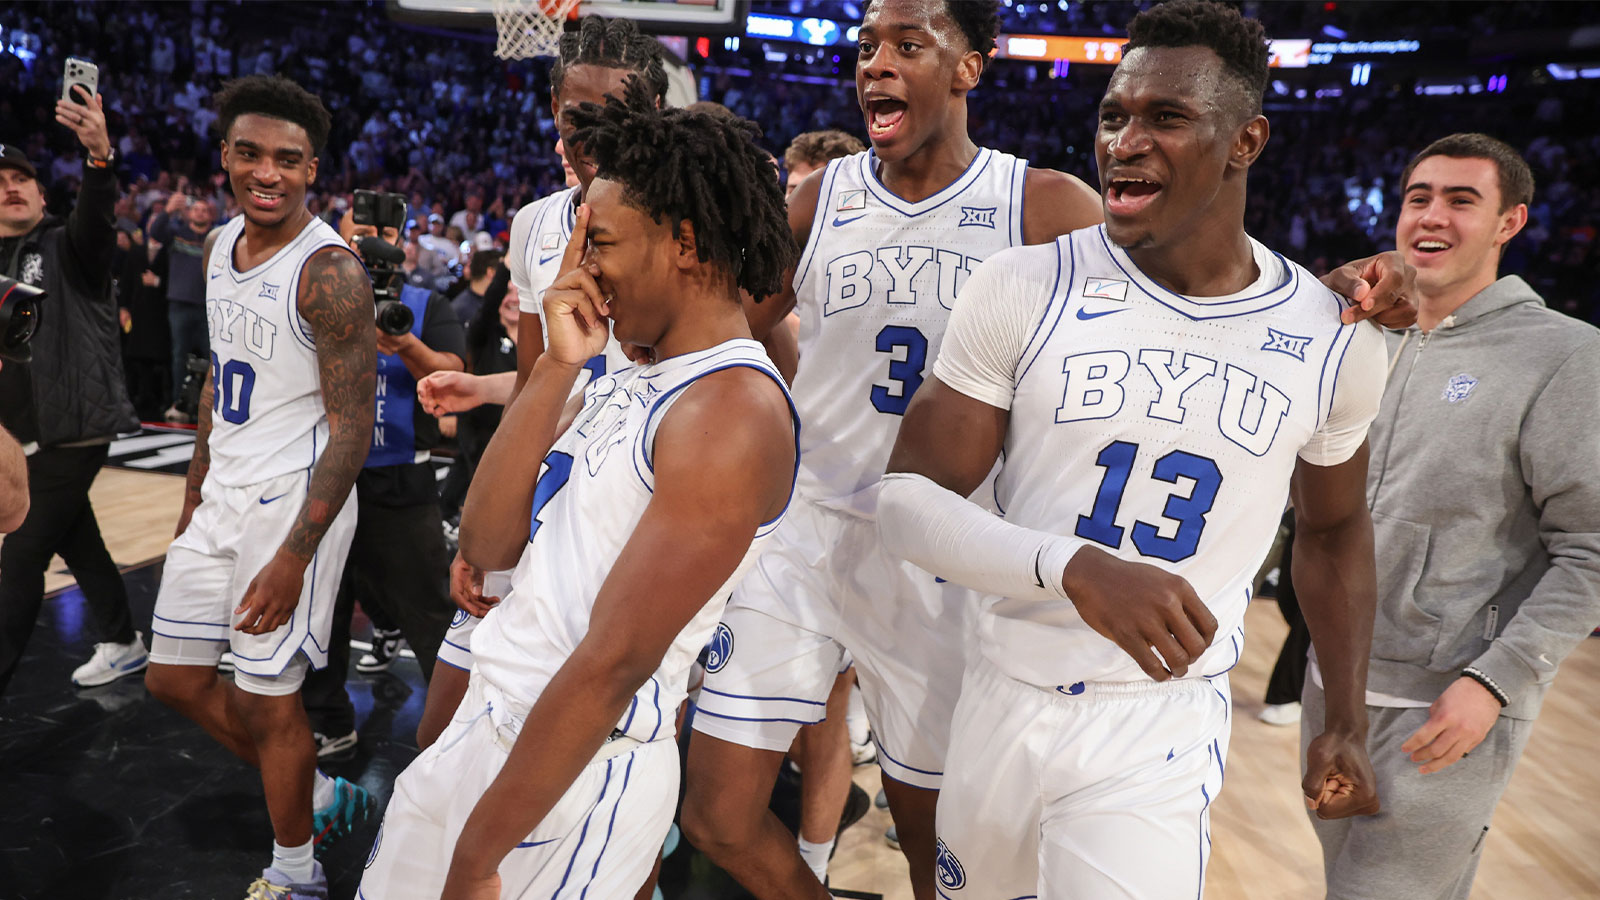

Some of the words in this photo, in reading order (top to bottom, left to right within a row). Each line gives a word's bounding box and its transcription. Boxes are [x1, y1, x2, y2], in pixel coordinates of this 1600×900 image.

[958, 206, 997, 229] XII
[870, 325, 928, 416] 3
[1261, 327, 1313, 362] XII
[1054, 349, 1291, 457] BYU
[1074, 440, 1223, 563] 13
